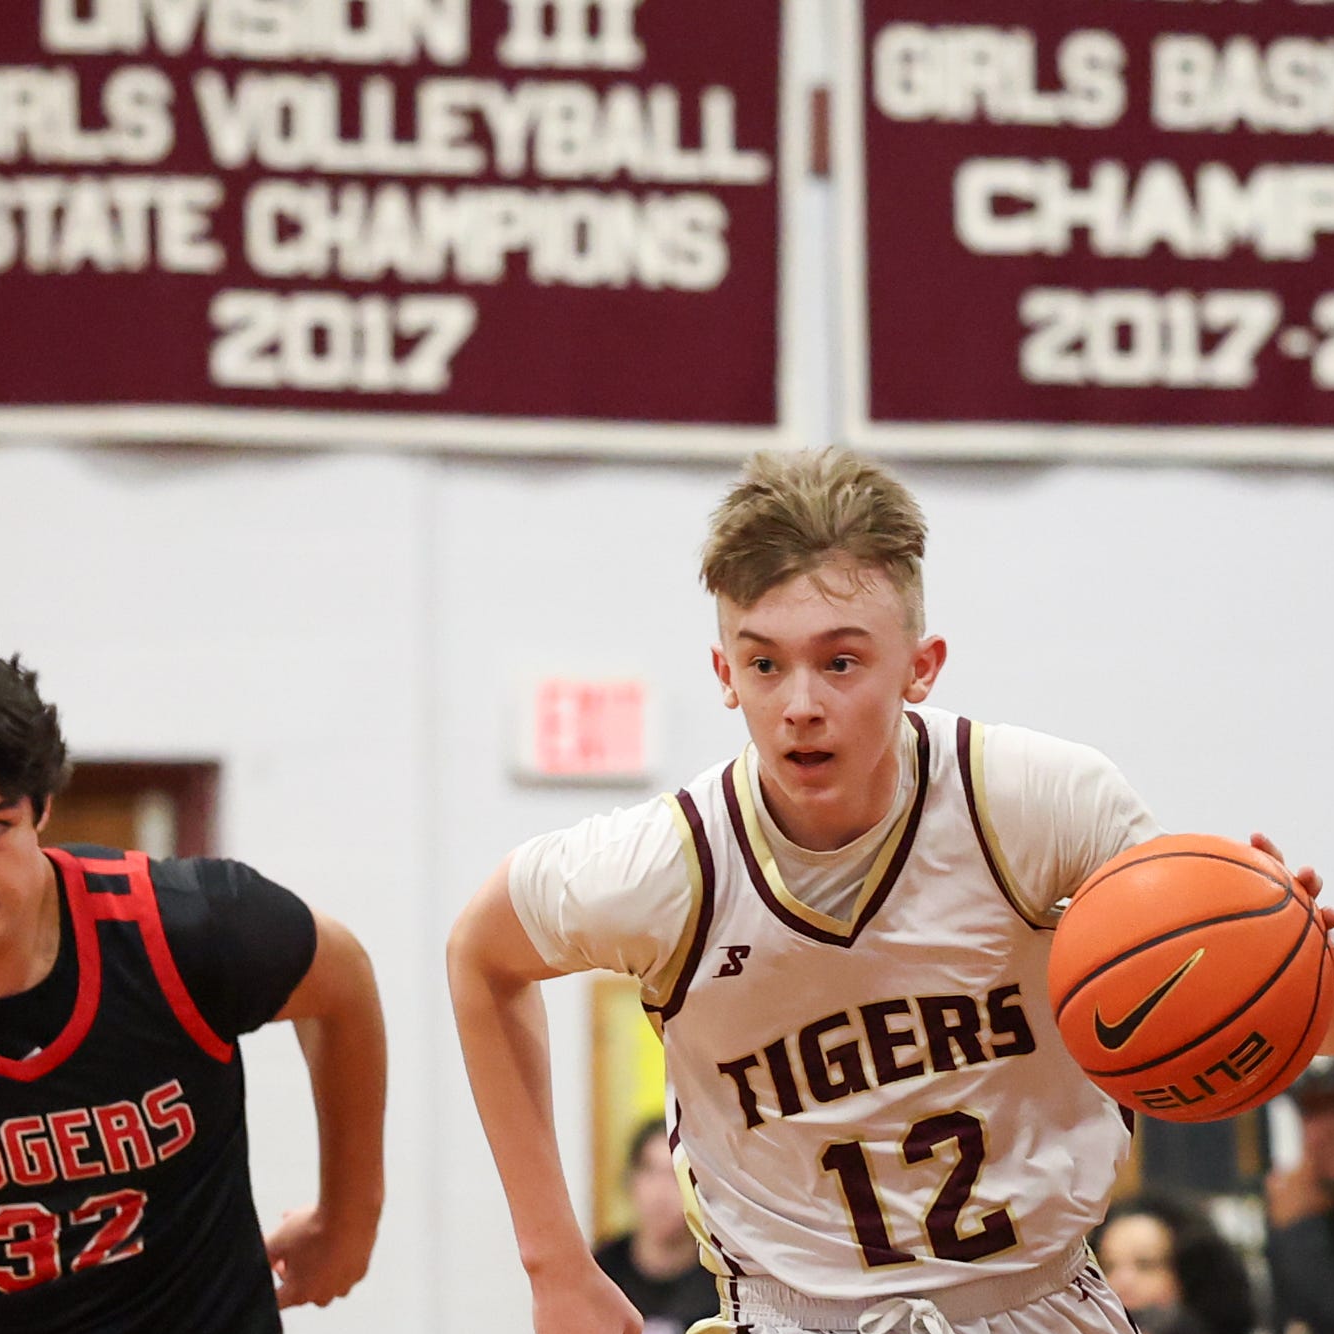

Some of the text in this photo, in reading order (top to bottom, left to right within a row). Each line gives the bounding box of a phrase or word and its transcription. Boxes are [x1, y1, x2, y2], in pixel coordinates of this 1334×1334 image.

[42, 0, 644, 69] DIVISION III
[874, 24, 1126, 128] GIRLS
[196, 72, 770, 185] VOLLEYBALL
[245, 181, 728, 291] CHAMPIONS
[210, 291, 477, 393] 2017
[717, 983, 1036, 1130] TIGERS
[1133, 1031, 1275, 1110] ELITE
[819, 1108, 1023, 1272] 12
